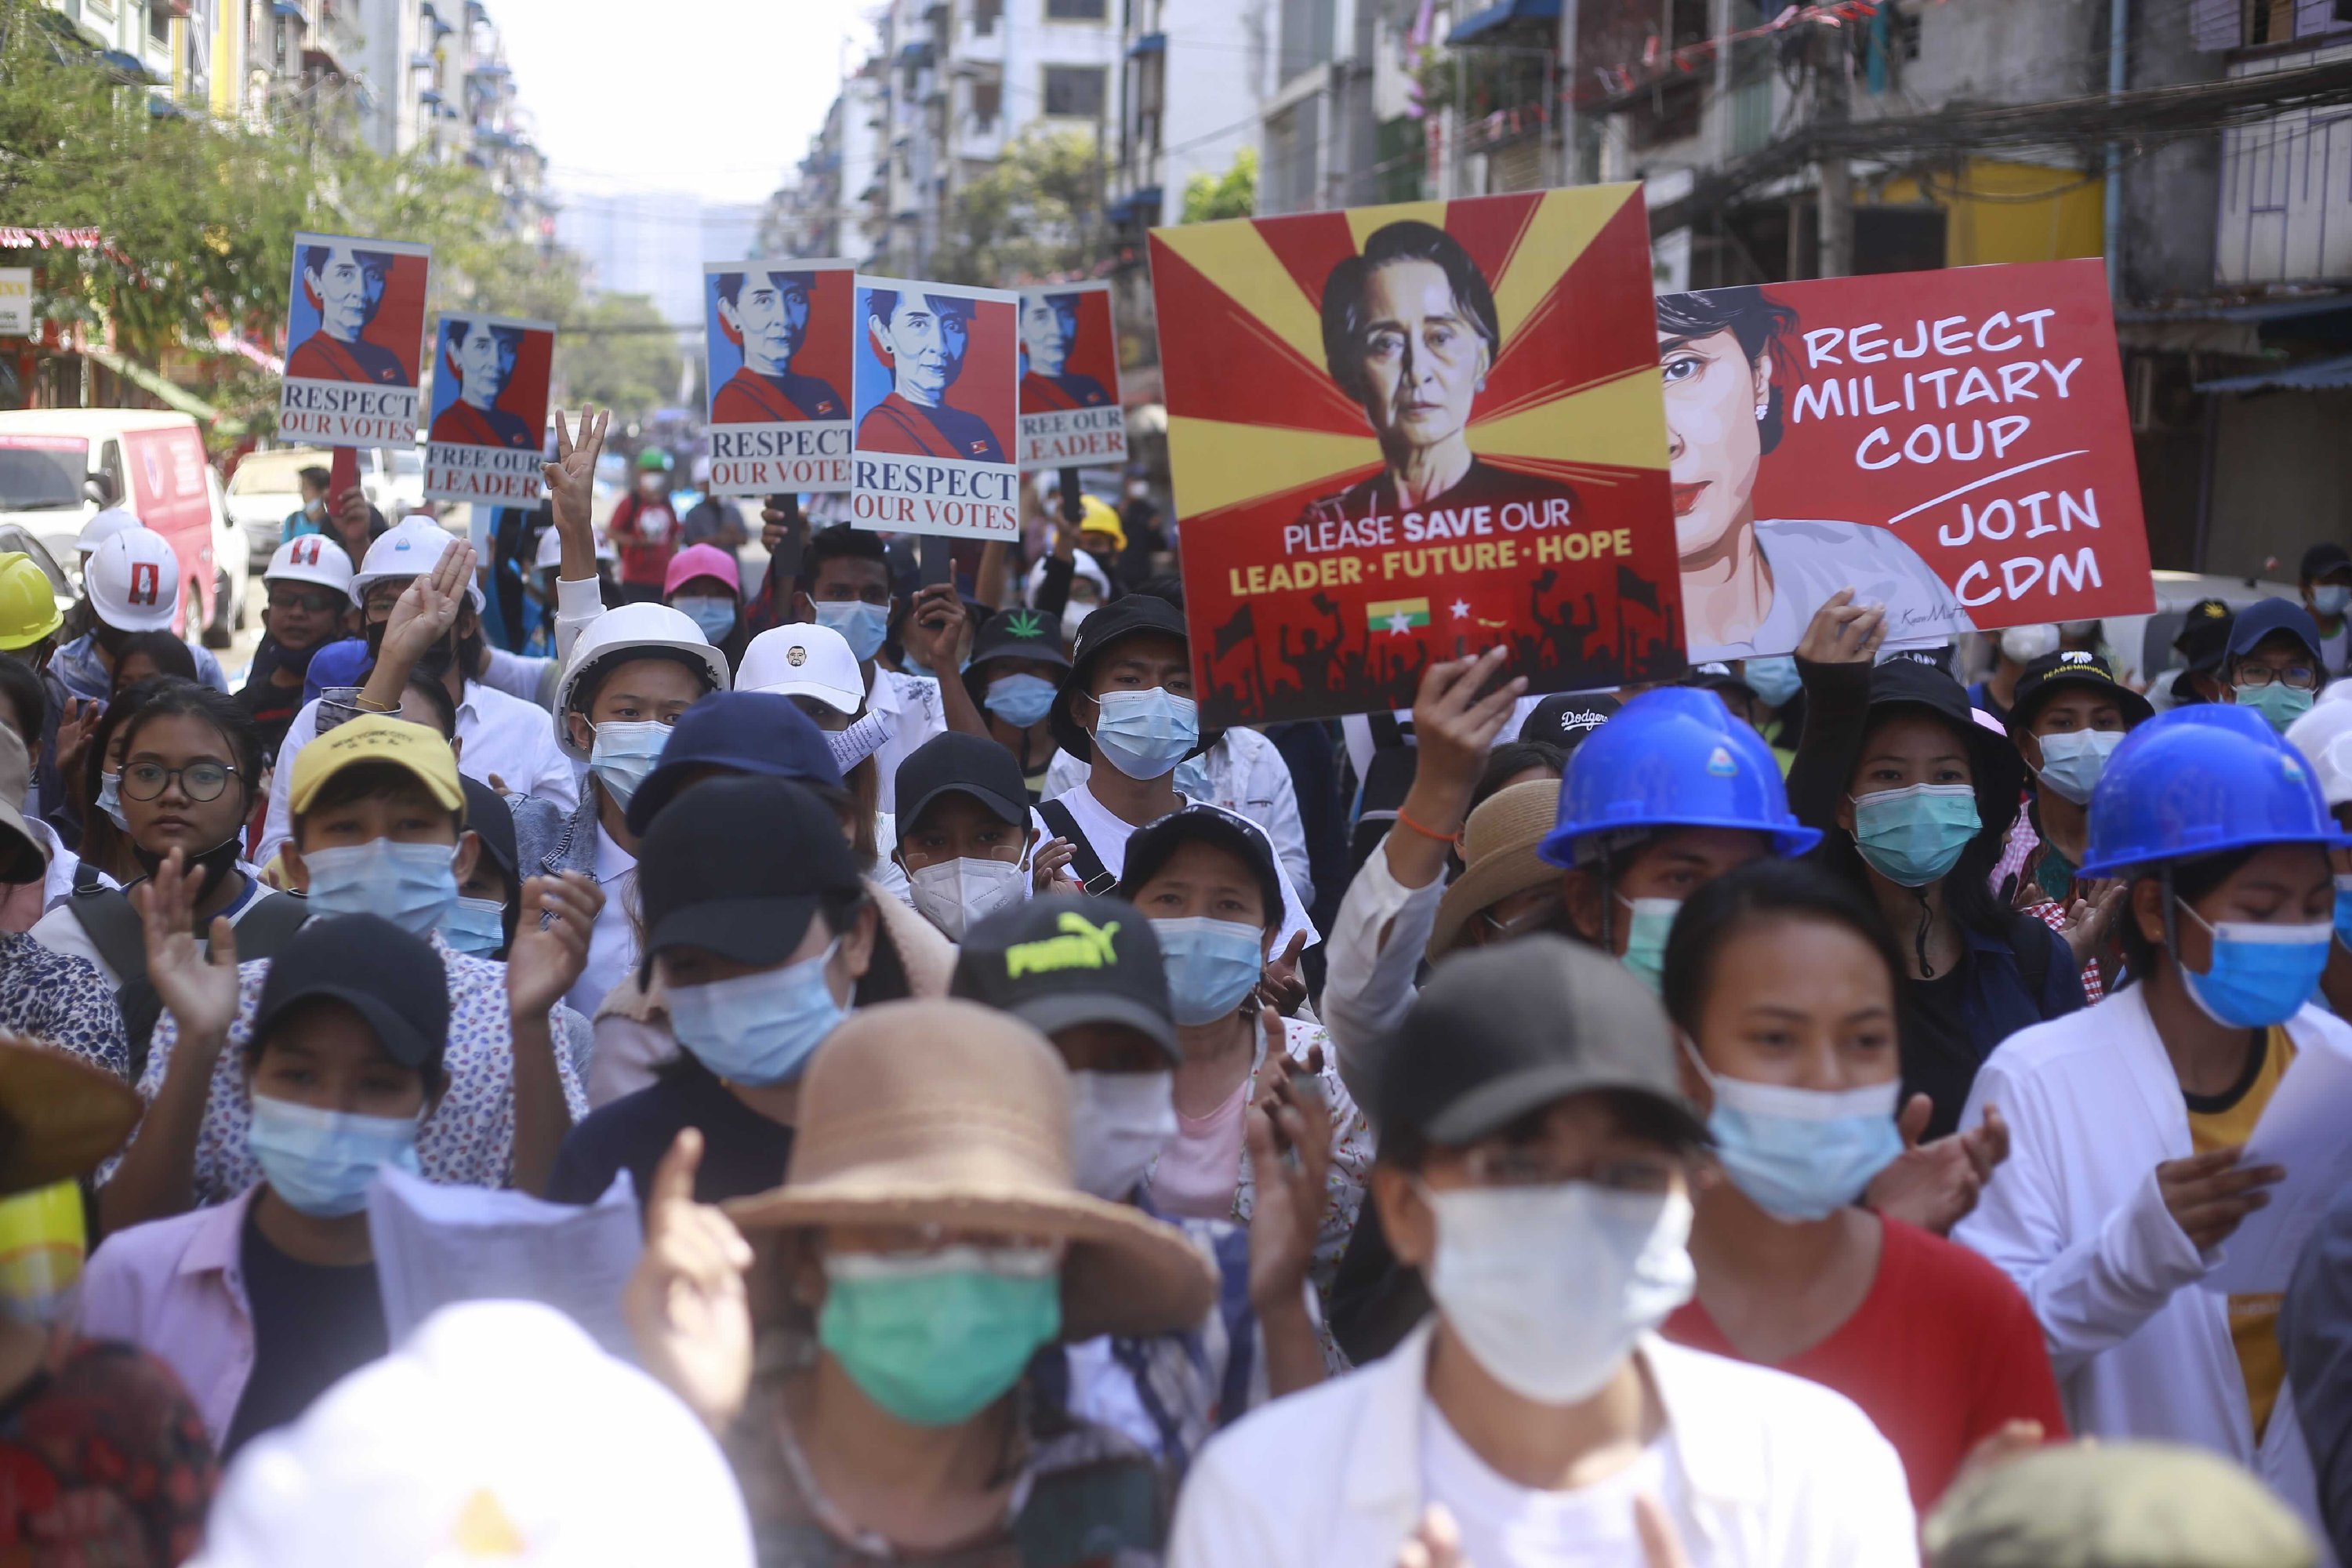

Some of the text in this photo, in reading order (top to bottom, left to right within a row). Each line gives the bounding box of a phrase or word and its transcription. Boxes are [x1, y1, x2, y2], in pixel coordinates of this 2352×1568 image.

[1803, 309, 2056, 369] REJECT
[285, 384, 417, 418] RESPECT
[1792, 358, 2083, 423] MILITARY
[281, 410, 414, 442] OUR VOTES
[1019, 409, 1122, 436] REE OUR
[428, 446, 541, 472] FREE OUR
[712, 428, 852, 459] RESPECT
[1020, 431, 1123, 461] EADER
[1856, 415, 2031, 470] COUP
[426, 468, 539, 499] LEADER
[711, 459, 852, 485] OUR VOTE
[855, 460, 1017, 501] RESPECT
[853, 494, 1017, 532] OUR VOTES
[1283, 499, 1571, 554] PLEASE SAVE OUR
[1939, 488, 2101, 547] JOIN
[1229, 528, 1632, 596] LEADER FUTURE HOPE
[1955, 547, 2102, 607] CDM
